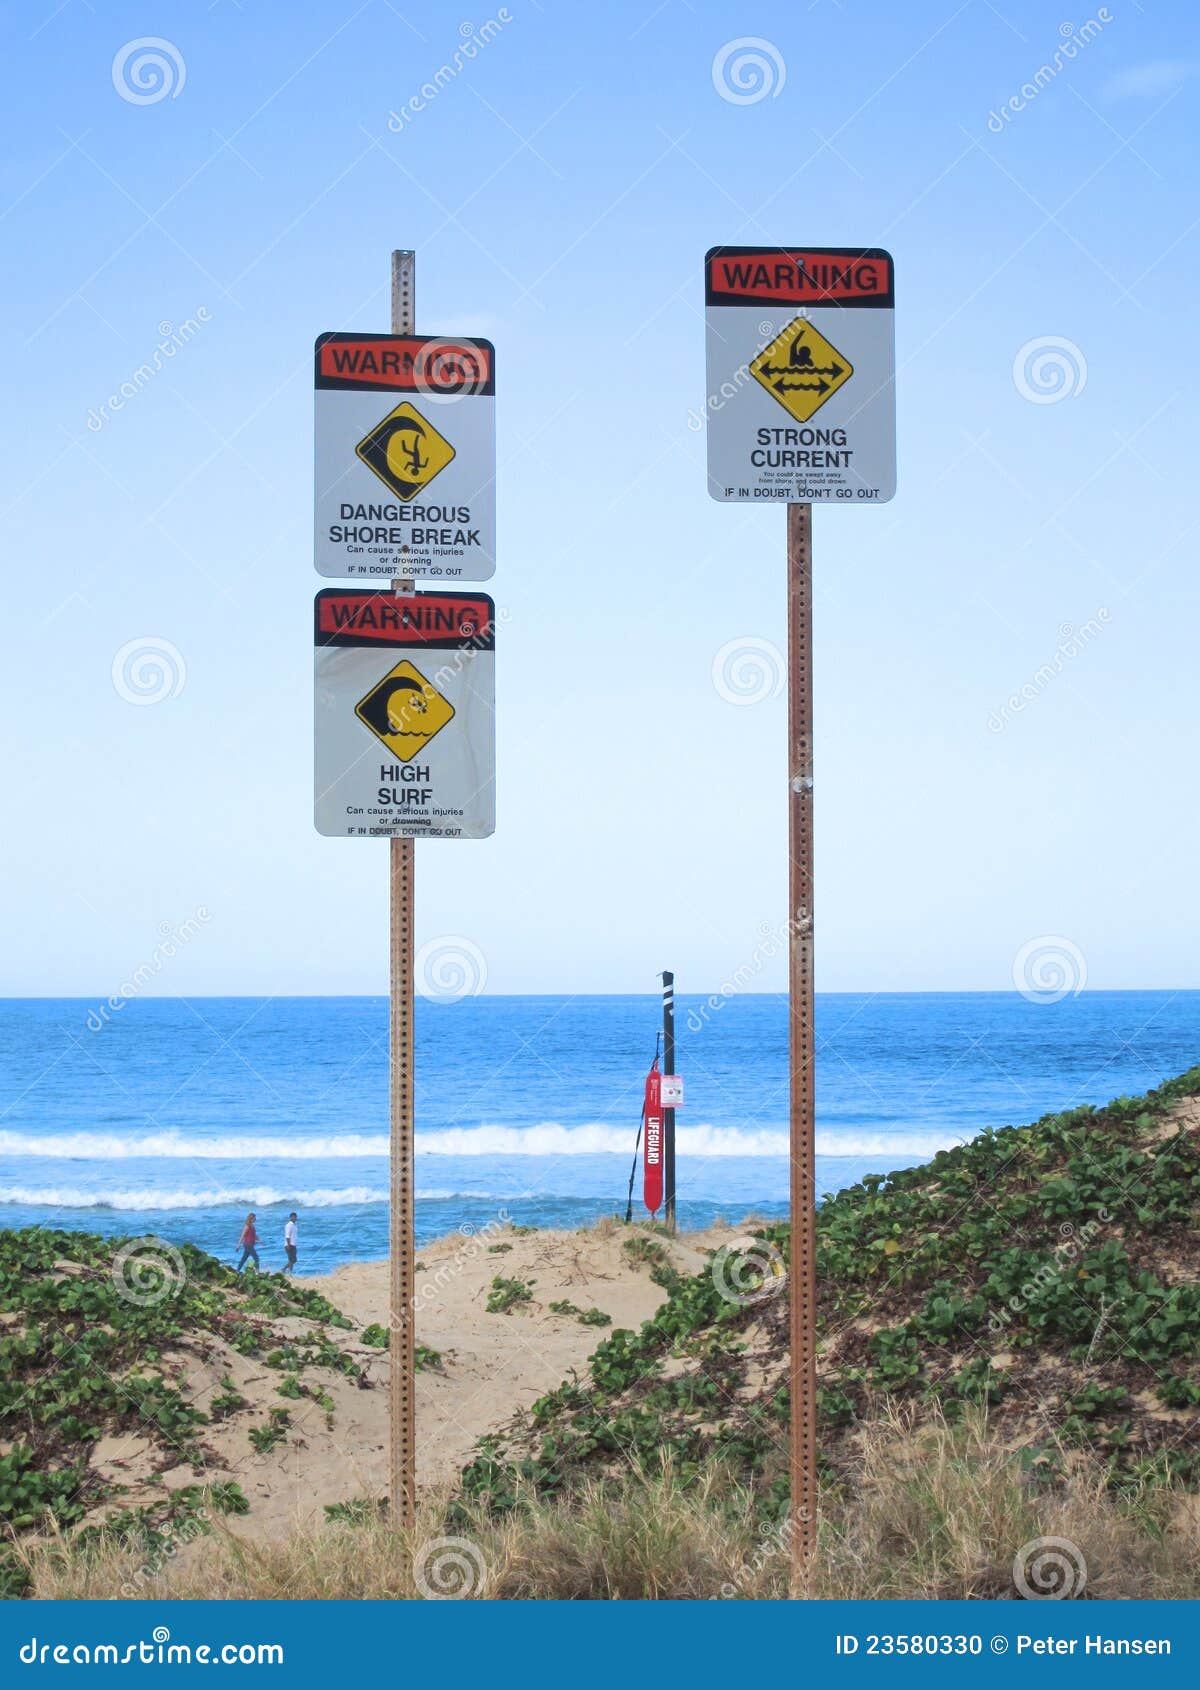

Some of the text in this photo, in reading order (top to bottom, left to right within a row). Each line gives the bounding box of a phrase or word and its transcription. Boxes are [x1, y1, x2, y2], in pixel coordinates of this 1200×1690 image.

[723, 263, 878, 291] WARNING
[332, 348, 479, 379] WARNING
[757, 428, 847, 447] STRONG
[750, 450, 853, 468] CURRENT
[725, 488, 880, 499] IF IN DOUBT, DON'T GO OUT
[340, 503, 471, 524] DANGEROUS
[329, 525, 481, 547] SHORE BREAK
[346, 545, 464, 556] Can cause srious injuries
[392, 557, 432, 566] drowning
[358, 566, 367, 574] IN
[369, 566, 399, 575] DOUBT,
[402, 567, 427, 575] DON'T
[430, 567, 443, 575] GO
[445, 568, 462, 576] OUT
[331, 604, 479, 632] WARNING
[380, 765, 430, 782] HIGH
[377, 788, 433, 805] SURF
[346, 806, 464, 816] Can cause serious injuries
[379, 817, 431, 826] or drowning
[445, 828, 462, 836] OUT
[647, 1116, 660, 1165] LIFEGUARD
